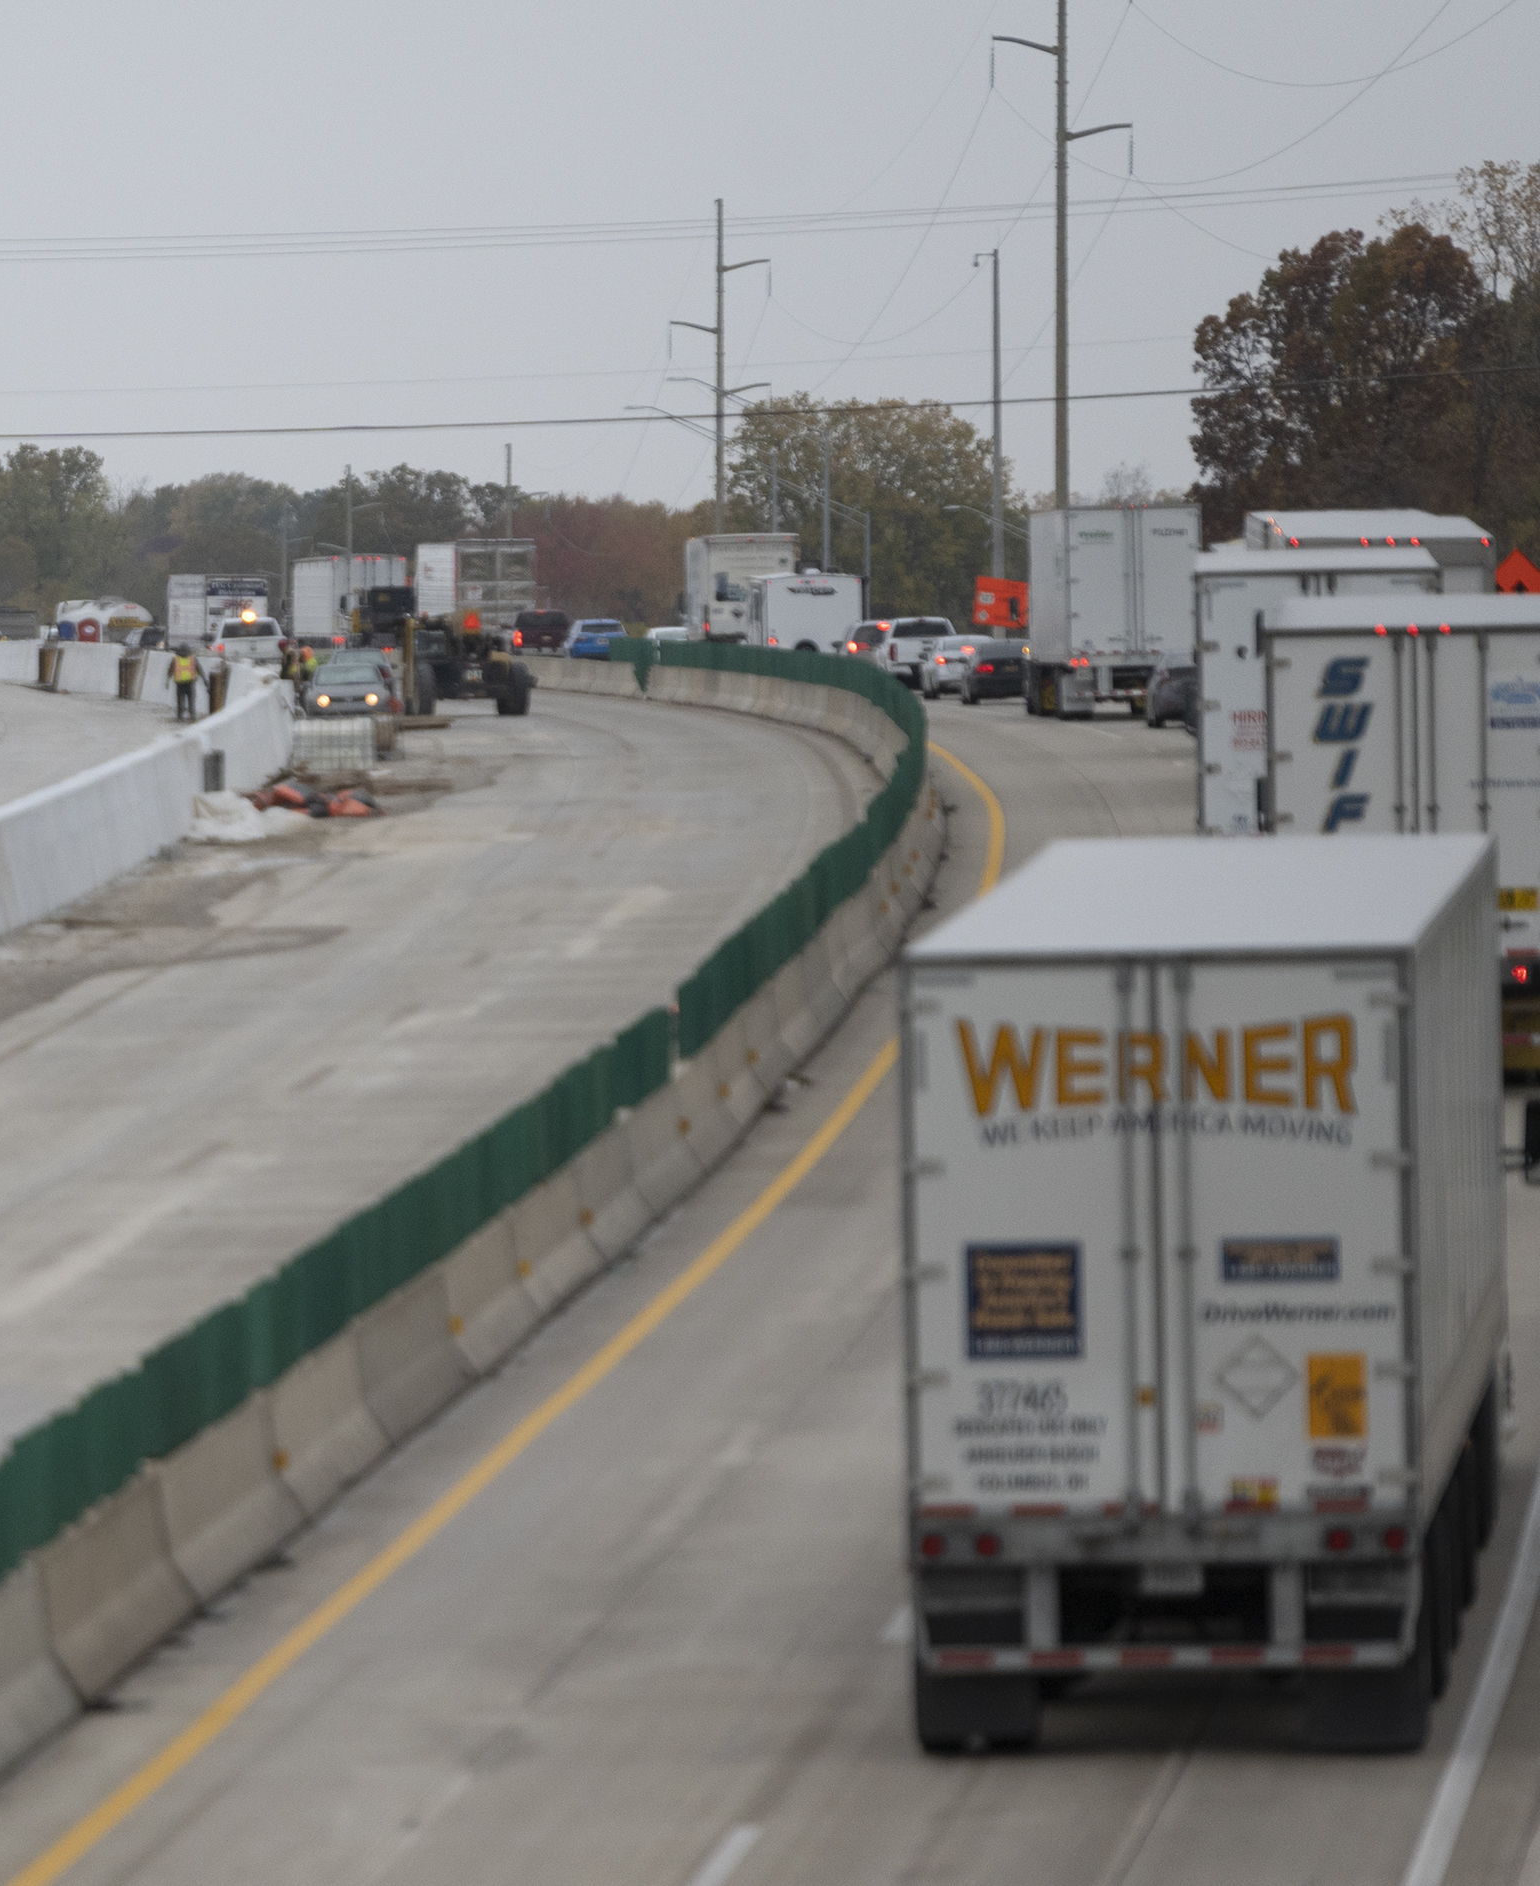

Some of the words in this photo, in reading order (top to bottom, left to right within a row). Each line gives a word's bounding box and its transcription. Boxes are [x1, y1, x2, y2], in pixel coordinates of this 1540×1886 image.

[955, 1012, 1359, 1117] WERNER
[981, 1120, 1018, 1148] WE
[1030, 1115, 1104, 1141] KEEP
[1242, 1113, 1353, 1146] MOVING
[1204, 1301, 1396, 1323] DriveWerner.com
